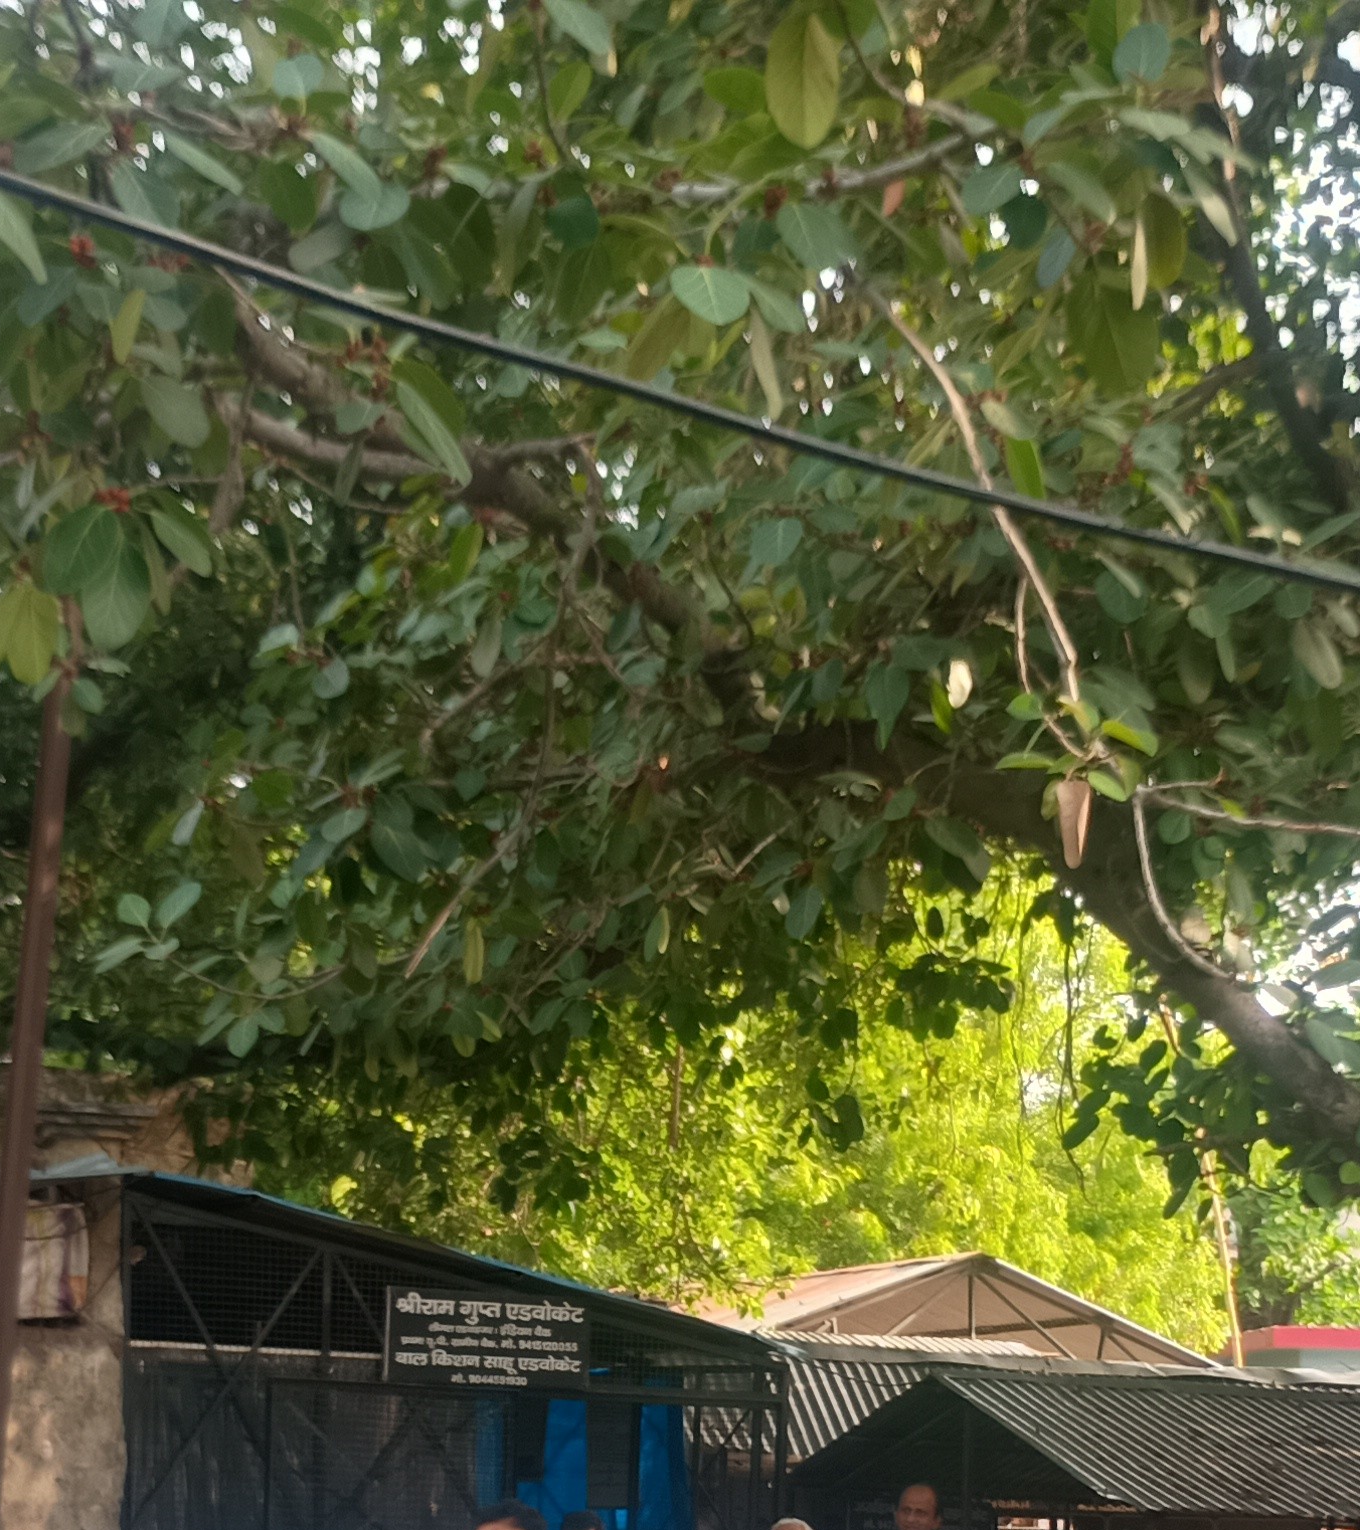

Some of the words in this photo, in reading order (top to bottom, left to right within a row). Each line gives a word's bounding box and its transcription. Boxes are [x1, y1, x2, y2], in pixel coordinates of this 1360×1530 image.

[396, 1292, 456, 1316] श्रीराम
[459, 1301, 503, 1325] गुप्त
[505, 1300, 585, 1323] एडवोकेट
[431, 1349, 481, 1368] किशन
[483, 1356, 518, 1375] साहू
[519, 1355, 582, 1373] एडवोकेट
[451, 1372, 467, 1384] मो.
